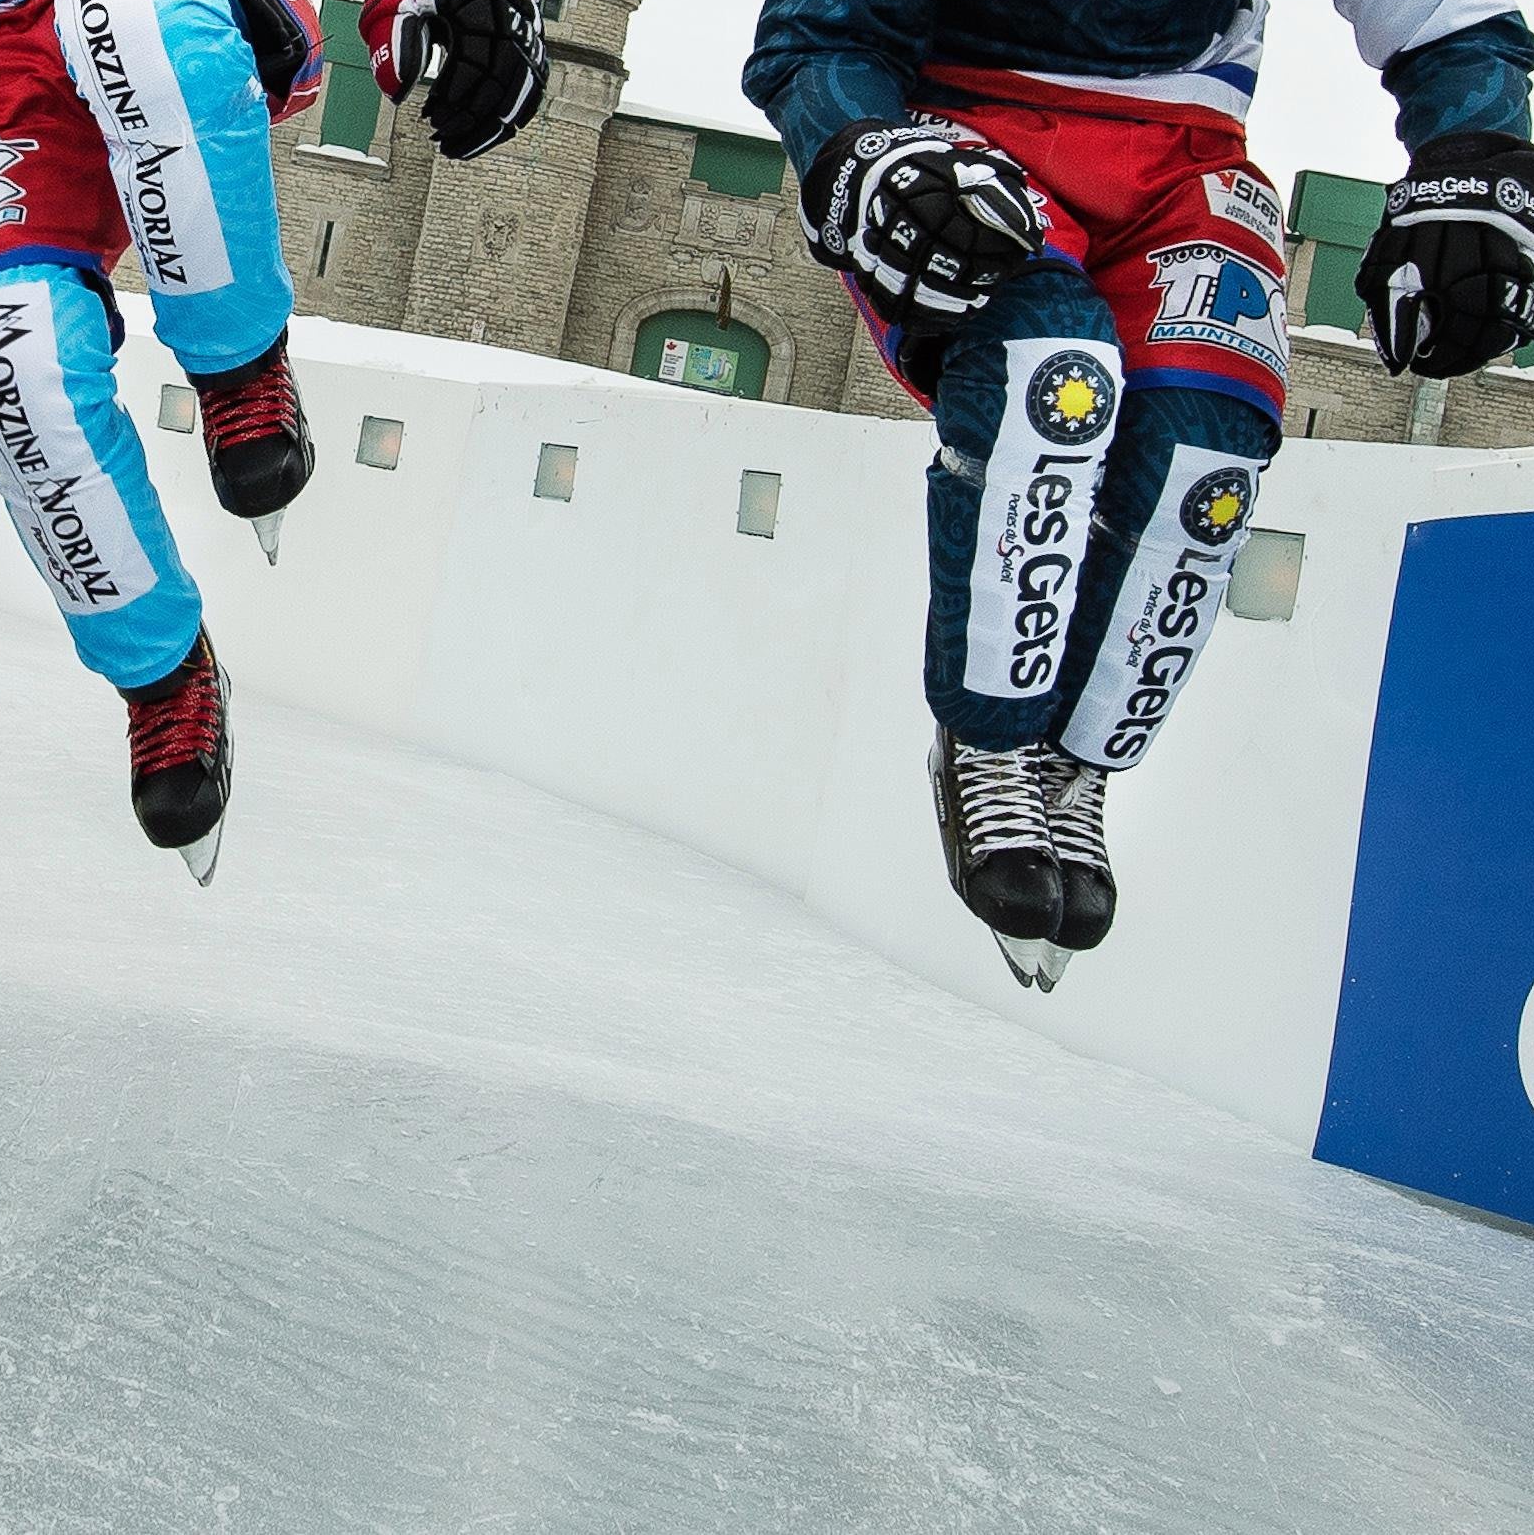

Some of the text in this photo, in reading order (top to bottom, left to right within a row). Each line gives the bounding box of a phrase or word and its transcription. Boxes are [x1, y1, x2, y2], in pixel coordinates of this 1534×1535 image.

[833, 157, 858, 200] Gets
[1233, 178, 1279, 227] Step
[1411, 176, 1489, 197] Les Gets
[128, 138, 189, 286] AVORIAZ
[1005, 492, 1021, 529] Portes
[29, 475, 120, 605] AVORIAZ
[997, 534, 1025, 584] Soleil
[1009, 453, 1093, 690] Les Gets
[1145, 583, 1163, 617] Portes
[1104, 547, 1225, 760] Les Gets
[1126, 621, 1156, 667] Soleil
